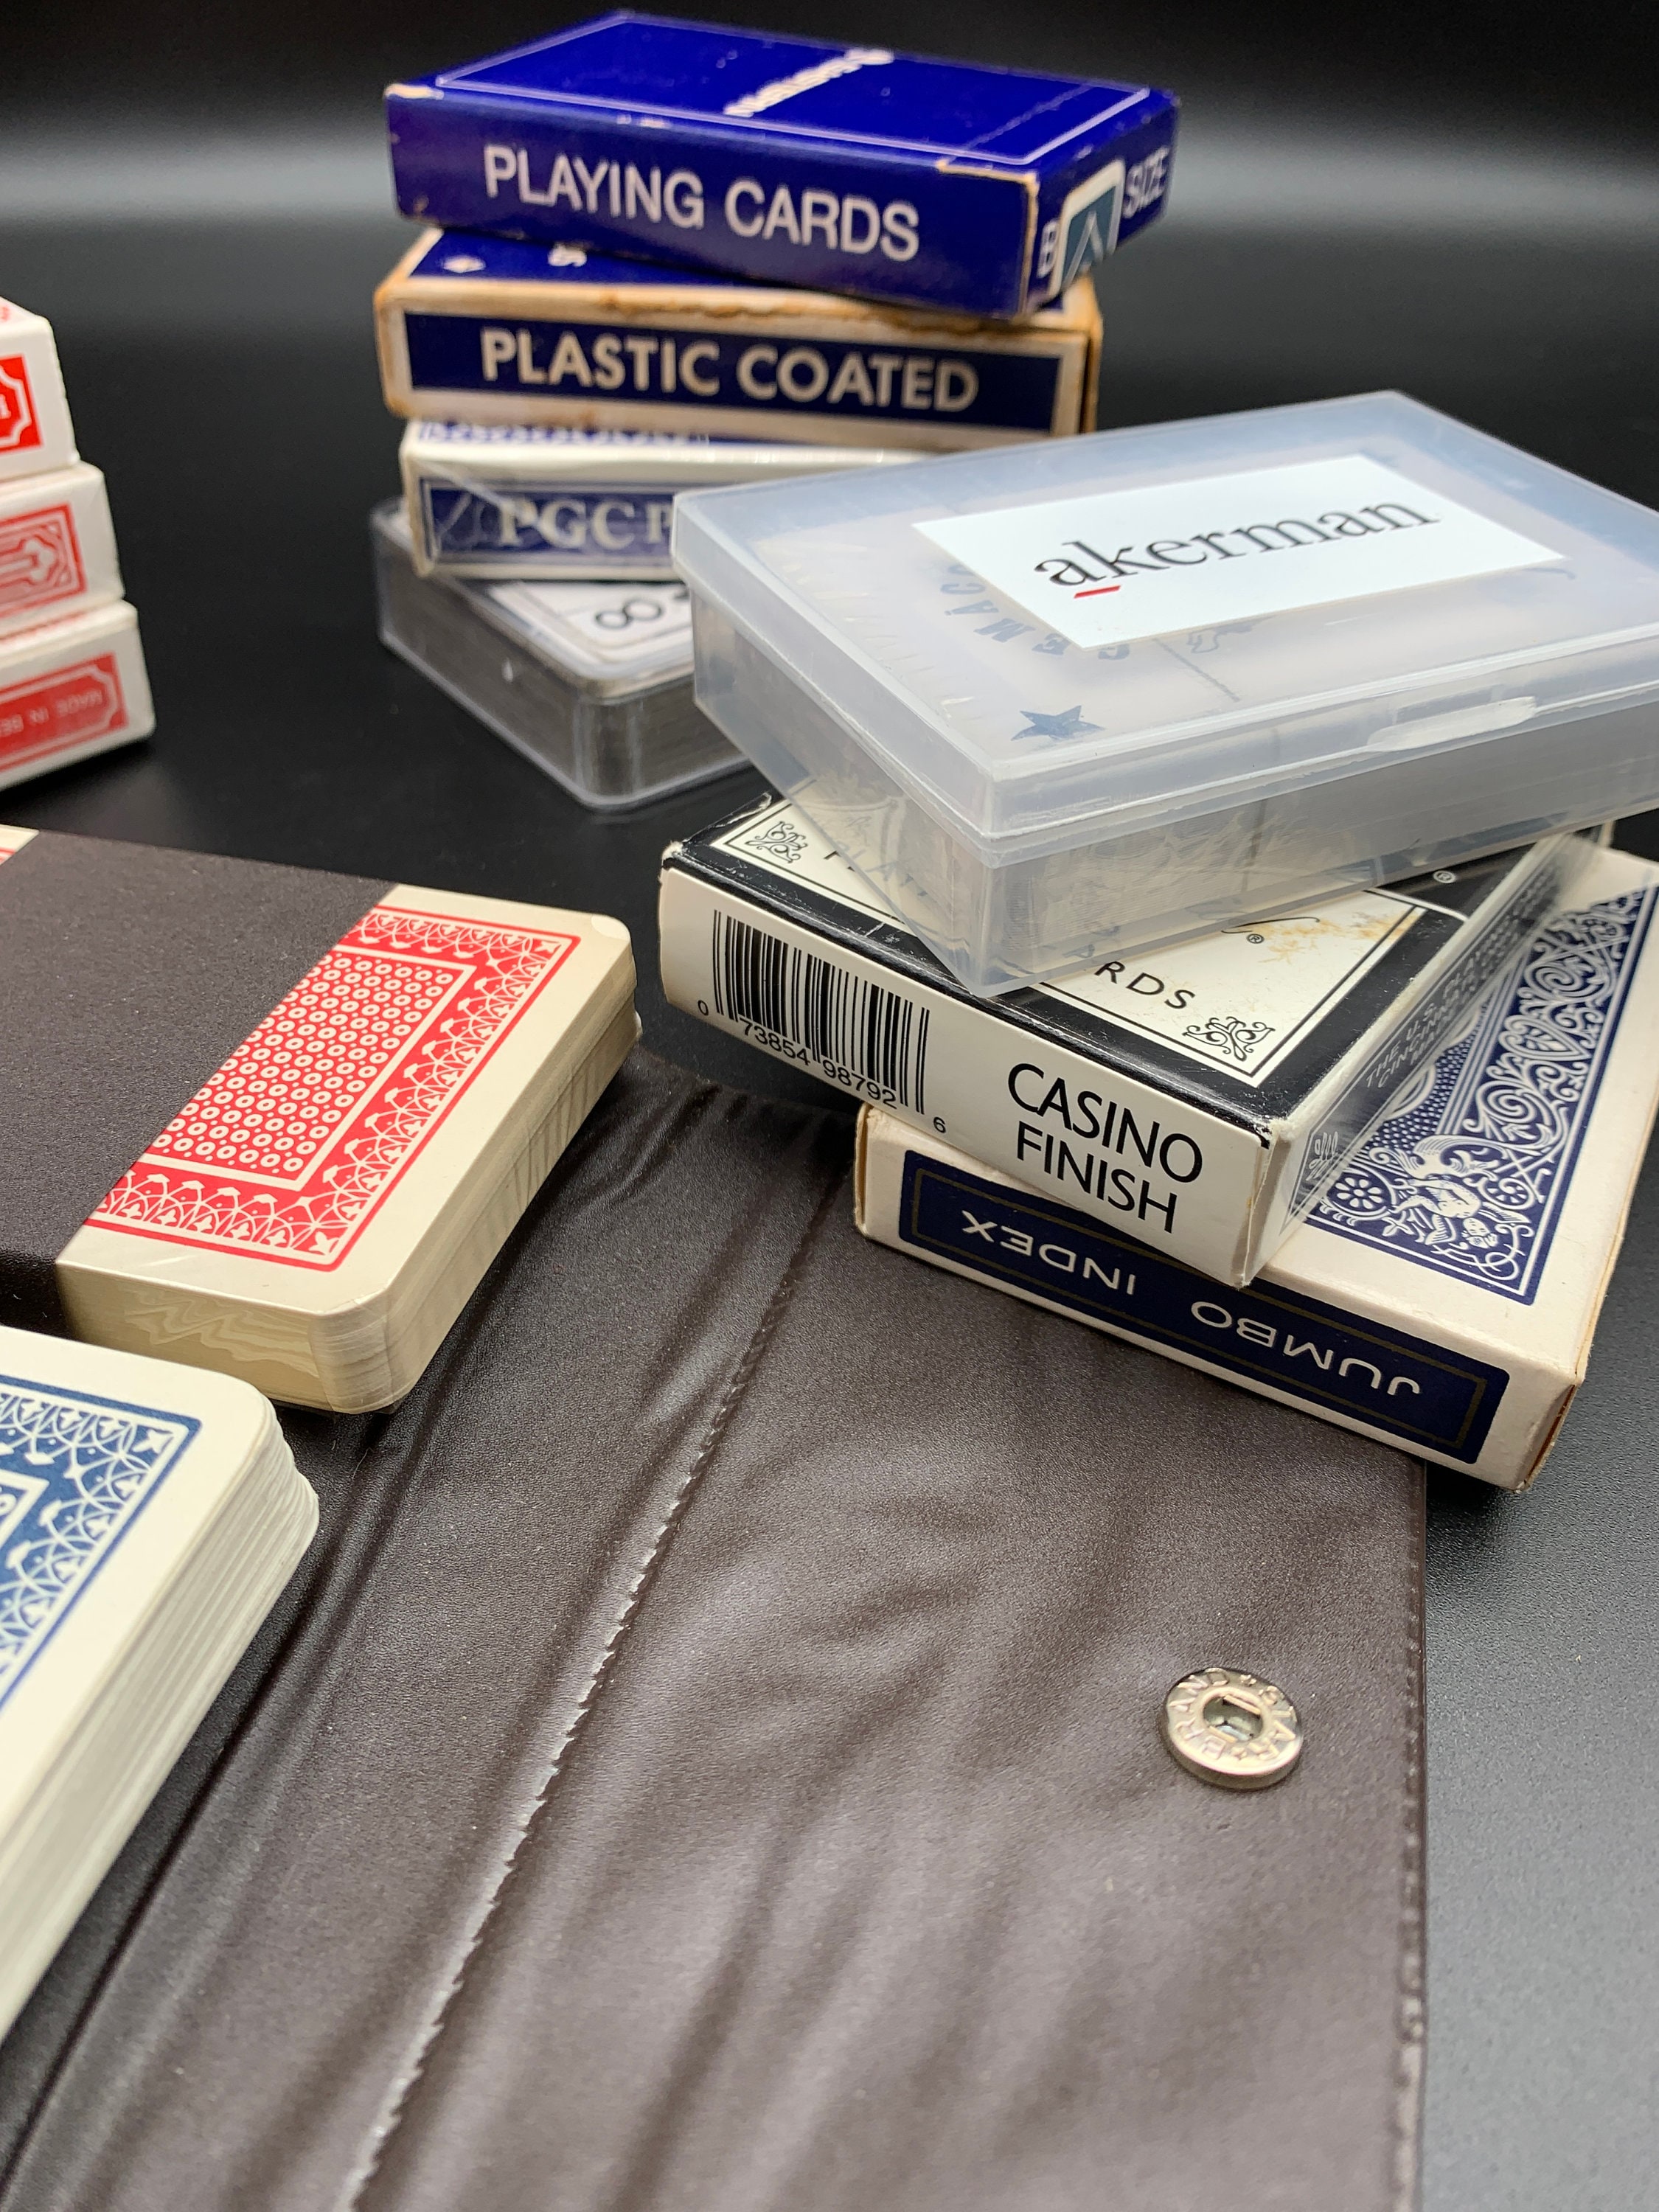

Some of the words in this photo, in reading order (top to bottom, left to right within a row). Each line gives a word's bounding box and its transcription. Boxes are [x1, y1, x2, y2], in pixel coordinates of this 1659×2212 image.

[483, 145, 704, 230] PLAYING
[724, 178, 920, 262] CARDS
[1122, 145, 1170, 220] SIZE
[479, 326, 721, 397] PLASTIC
[737, 344, 979, 413] COATED
[1034, 500, 1441, 587] akerman
[1093, 961, 1196, 1010] RDS
[697, 1000, 709, 1016] 0
[738, 1017, 811, 1066] 73854
[822, 1060, 897, 1110] 98792
[932, 1116, 947, 1133] 6
[1007, 1062, 1203, 1183] CASINO
[1017, 1120, 1178, 1234] FINISH
[961, 1210, 1136, 1295] INDEX
[1190, 1301, 1421, 1396] JUMBO
